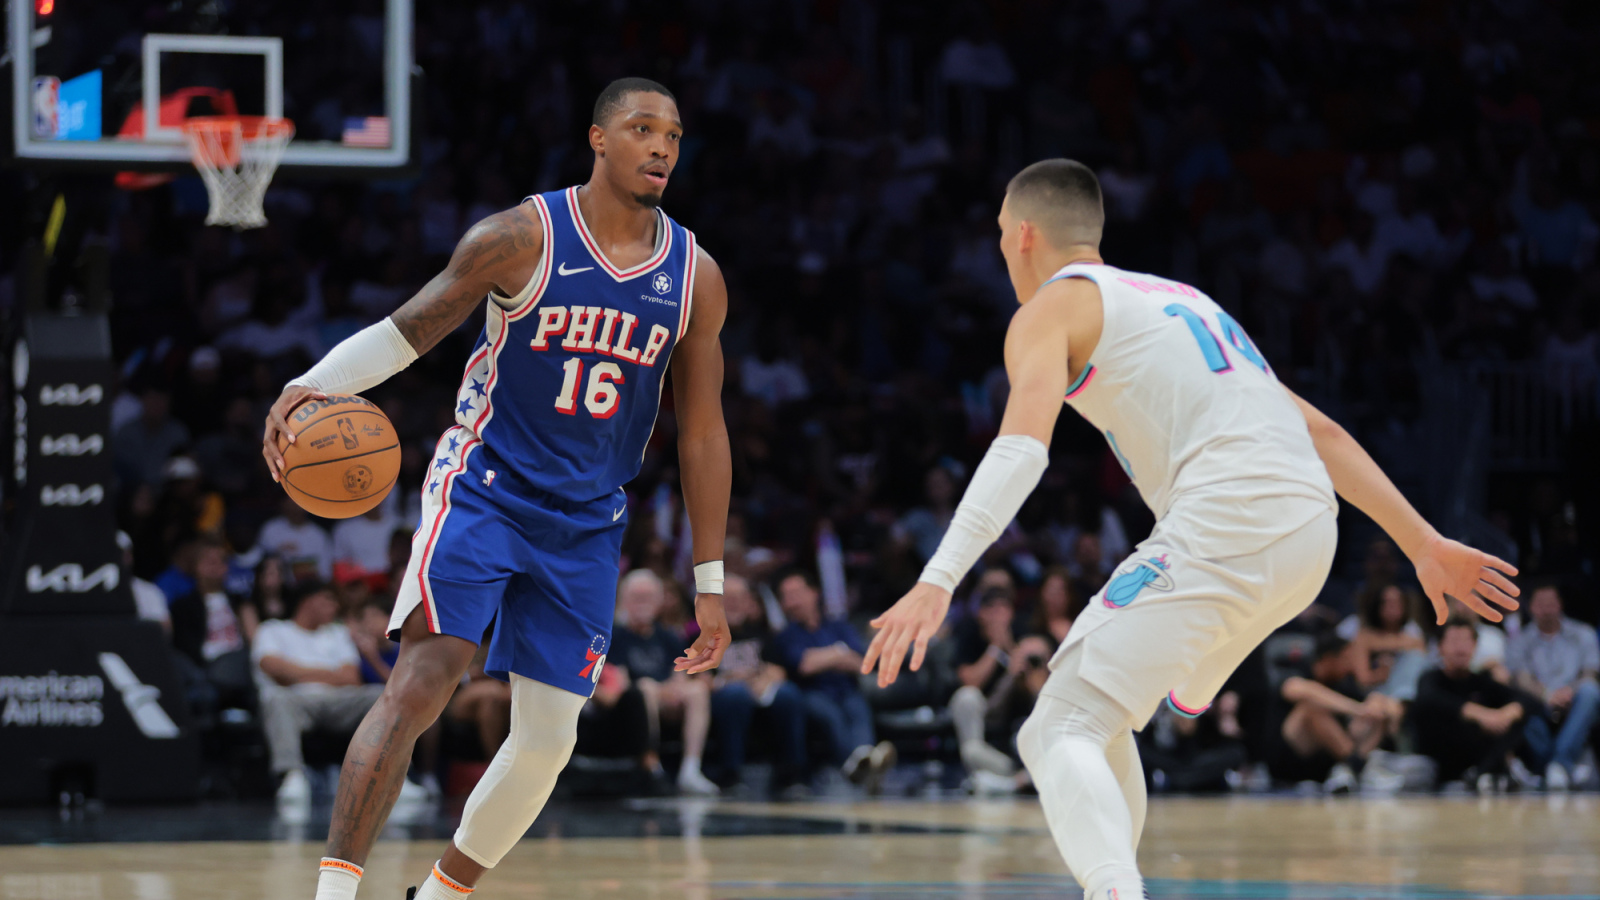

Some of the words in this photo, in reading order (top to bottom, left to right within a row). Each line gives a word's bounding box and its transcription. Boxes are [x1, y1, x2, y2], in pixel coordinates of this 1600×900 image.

[641, 294, 678, 307] crypto.com
[530, 305, 670, 367] PHILA
[1163, 303, 1270, 376] 14
[555, 357, 625, 419] 16
[0, 670, 104, 699] merican
[2, 698, 104, 727] Airlines
